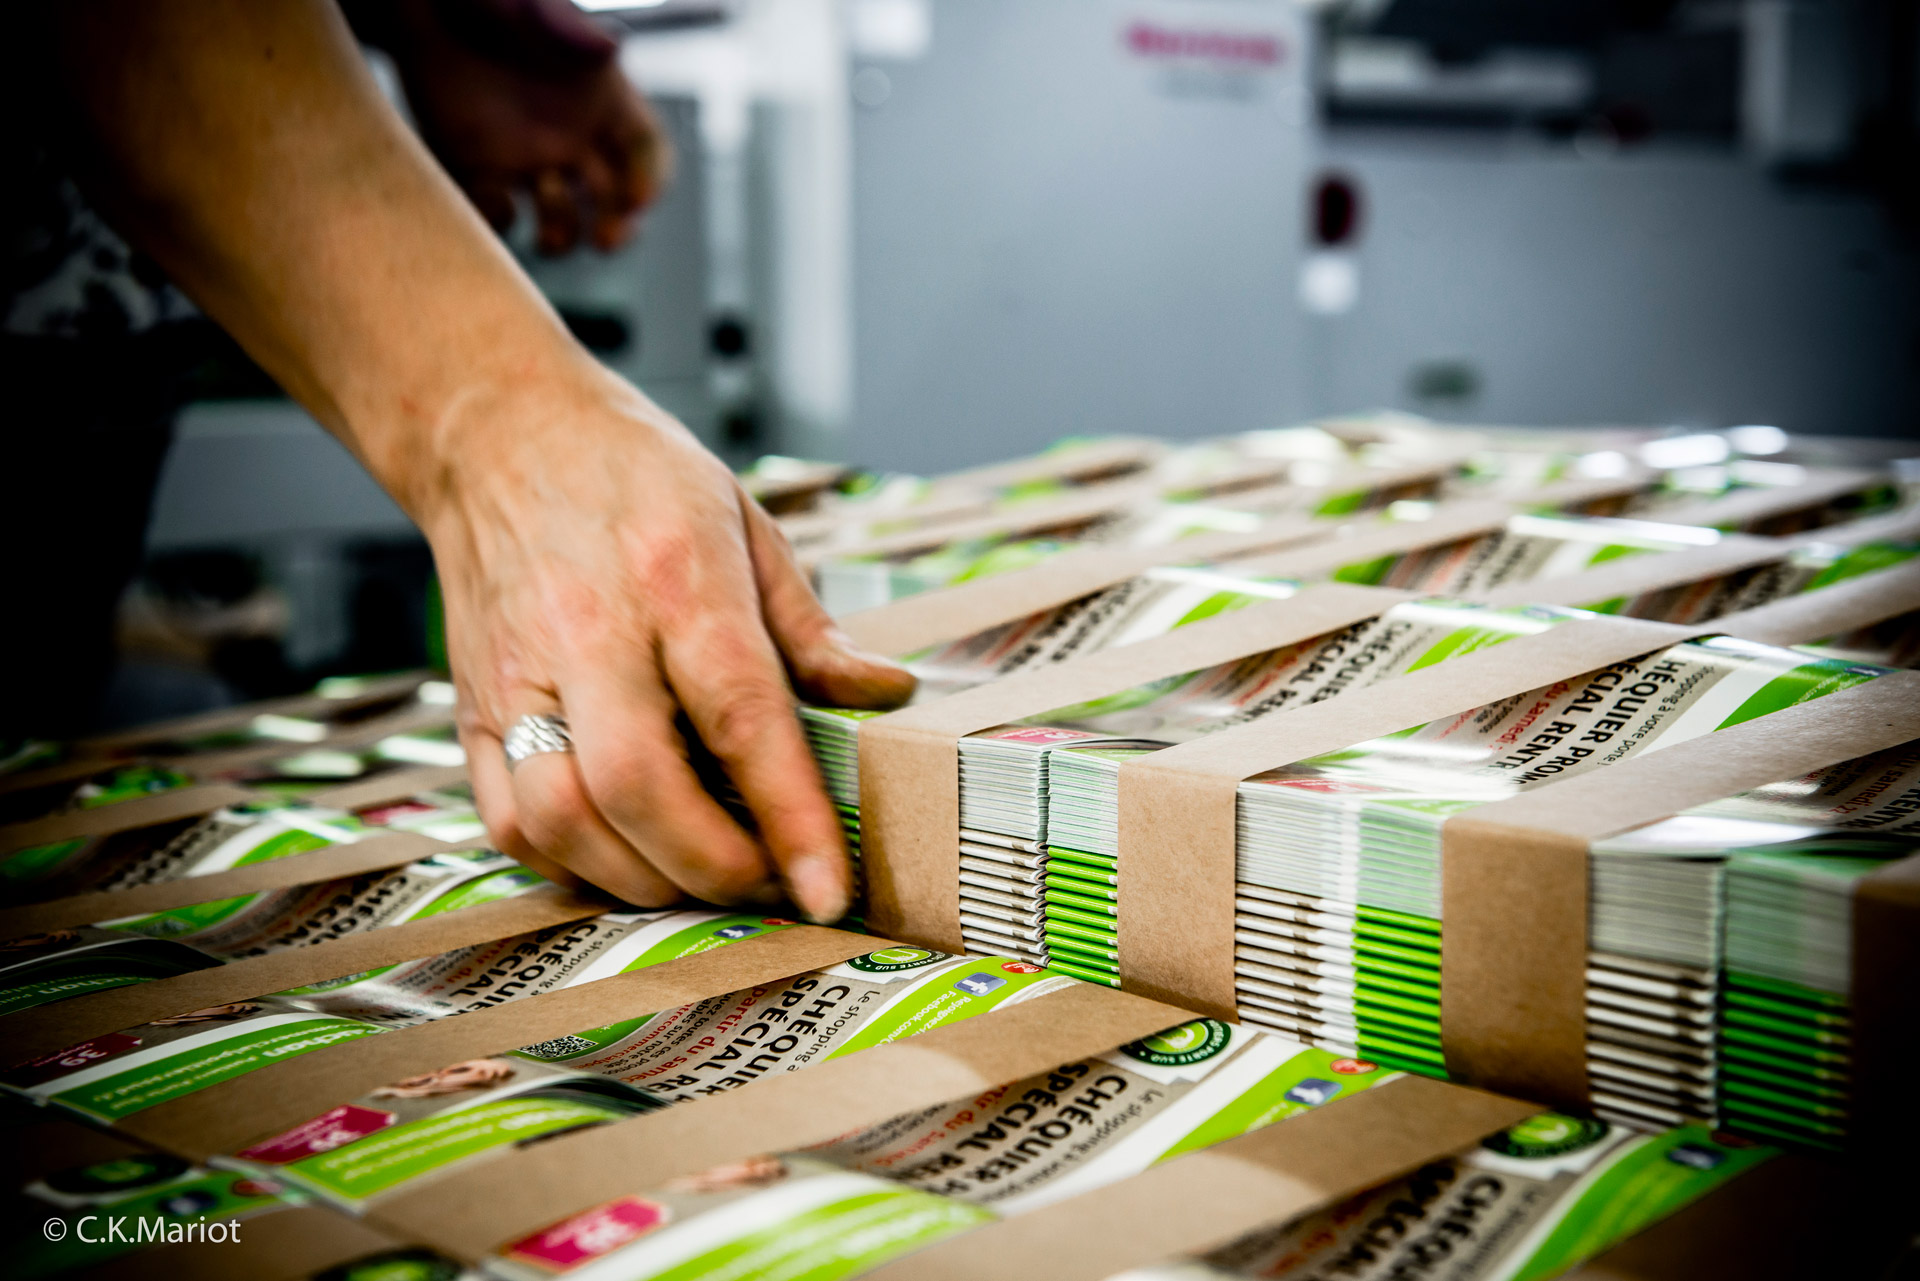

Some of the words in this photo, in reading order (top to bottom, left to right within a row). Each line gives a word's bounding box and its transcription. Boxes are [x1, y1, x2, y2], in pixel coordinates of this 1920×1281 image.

[1580, 660, 1686, 744] HÉQUIER
[1632, 714, 1664, 738] votre
[1603, 740, 1636, 762] porte
[539, 940, 602, 988] shopping
[716, 986, 768, 1034] partir
[858, 990, 880, 1003] Le
[664, 1025, 682, 1040] sur
[671, 1017, 710, 1046] toutes
[693, 976, 819, 1070] SPÉCIAL
[795, 1006, 859, 1063] shopping
[630, 1040, 663, 1060] notre
[650, 1046, 671, 1059] ces
[686, 1036, 715, 1055] du
[956, 1062, 1090, 1150] SPÉCIAL
[964, 1074, 1128, 1182] CHÉQUIER
